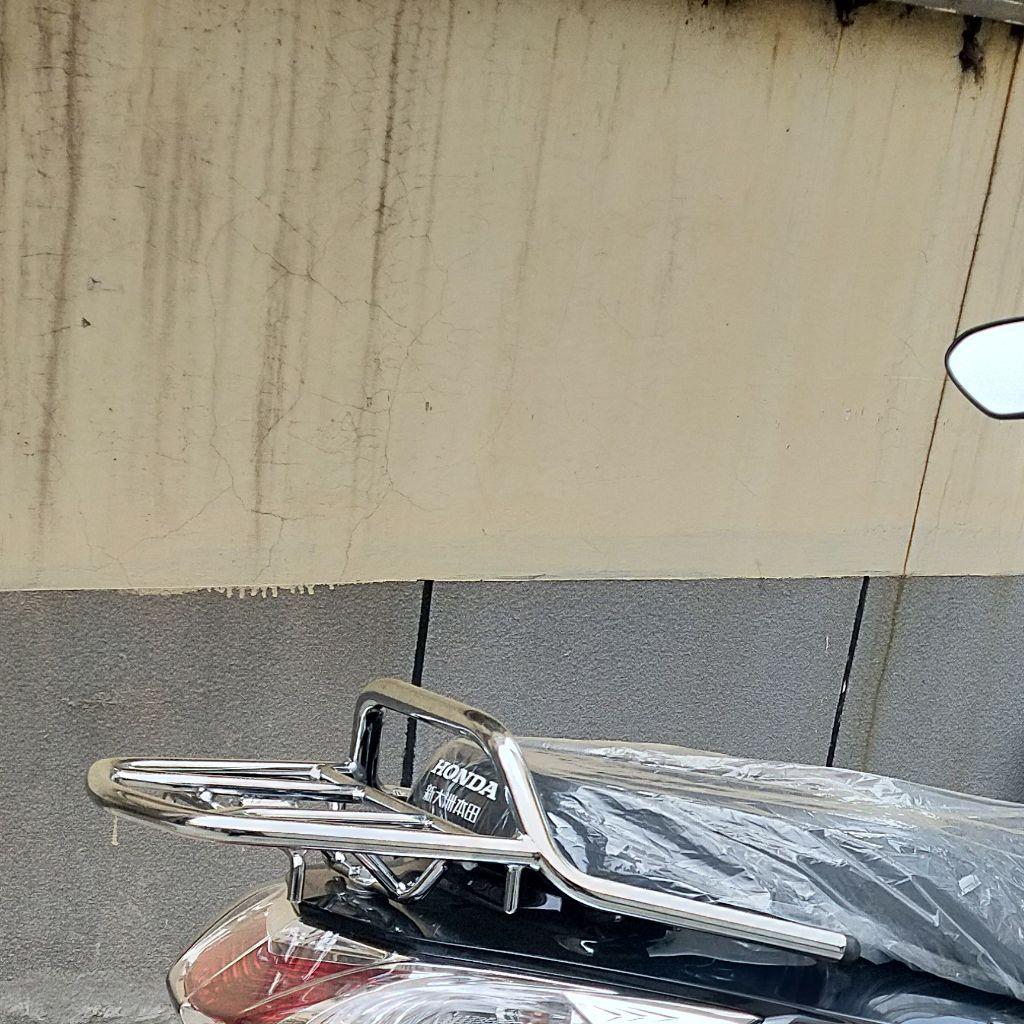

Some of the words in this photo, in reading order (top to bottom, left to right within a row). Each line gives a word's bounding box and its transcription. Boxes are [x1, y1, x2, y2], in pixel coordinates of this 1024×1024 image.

[430, 759, 498, 801] HONDA
[422, 784, 481, 824] 新大洲本田
